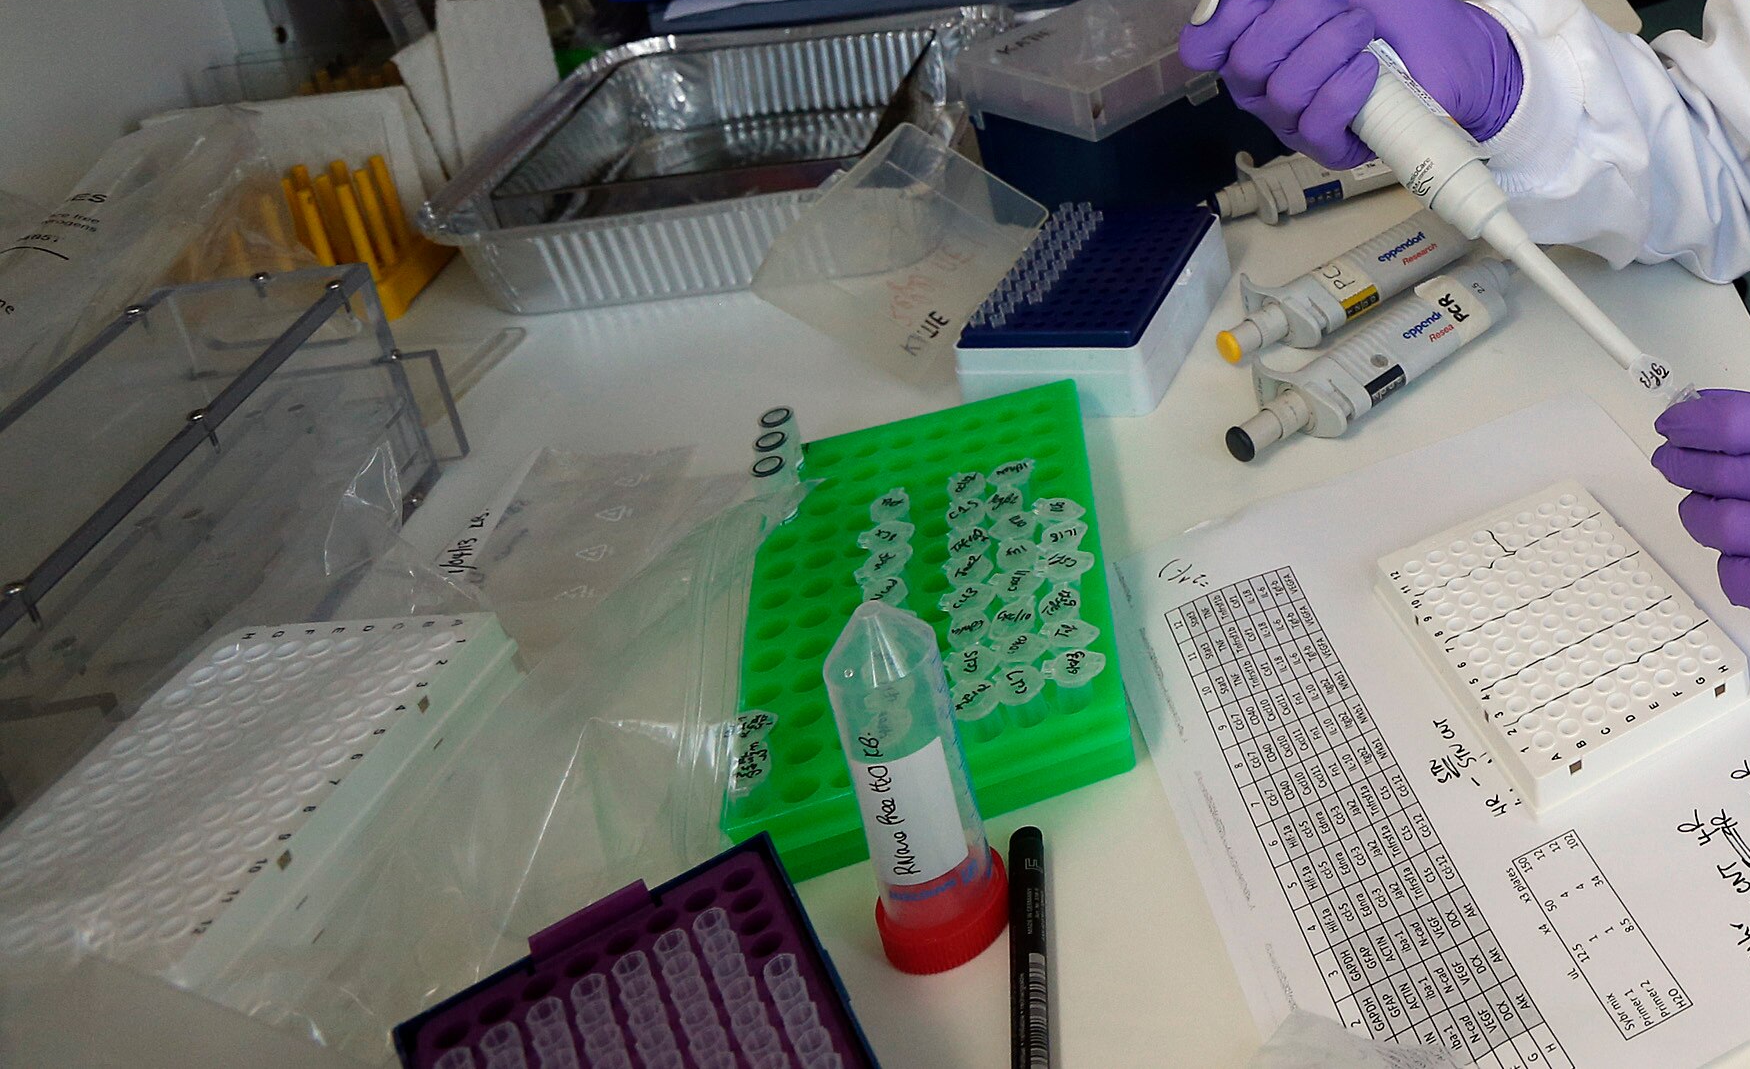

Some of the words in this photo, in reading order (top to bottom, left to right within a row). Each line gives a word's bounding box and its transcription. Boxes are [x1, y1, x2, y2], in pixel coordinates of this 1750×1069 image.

[1377, 230, 1427, 265] eppendorf
[1402, 242, 1438, 266] Research
[1438, 292, 1471, 323] PCR
[1402, 310, 1442, 341] eppend
[1428, 323, 1455, 344] Resea
[1389, 570, 1401, 580] 12
[1400, 585, 1411, 595] 11
[1411, 600, 1423, 609] 10
[1173, 619, 1184, 630] 12
[1435, 630, 1444, 638] 8
[1187, 651, 1198, 662] 11
[1457, 661, 1467, 669] 6
[1469, 677, 1480, 686] 5
[1201, 685, 1212, 696] 10
[1480, 694, 1491, 702] 4
[1494, 711, 1505, 720] 3
[1551, 751, 1563, 762] A
[1576, 740, 1587, 749] B
[1600, 726, 1611, 735] C
[1625, 714, 1636, 723] D
[1649, 701, 1660, 710] E
[1672, 690, 1683, 698] F
[1695, 677, 1706, 686] G
[1717, 664, 1729, 674] H
[1506, 728, 1517, 736] 2
[1520, 745, 1530, 754] 1
[1233, 761, 1244, 769] 8
[1267, 839, 1279, 847] 6
[1549, 841, 1562, 853] 12
[1563, 833, 1579, 850] 102
[1533, 848, 1546, 861] 12
[1518, 856, 1534, 874] 150
[1286, 881, 1298, 889] 5
[1505, 867, 1524, 894] plates
[1591, 875, 1604, 887] 34
[1519, 891, 1532, 904] x3
[1560, 891, 1569, 899] 4
[1544, 899, 1558, 912] 50
[1538, 922, 1552, 936] x4
[1604, 926, 1614, 934] 1
[1620, 917, 1635, 933] 8.5
[1588, 934, 1598, 942] 1
[1572, 942, 1591, 963] 12.5
[1327, 969, 1339, 978] 3
[1567, 966, 1580, 981] uL
[1640, 979, 1650, 988] 2
[1623, 988, 1633, 997] 1
[1668, 987, 1687, 1009] H2O
[1606, 992, 1625, 1011] mix
[1646, 987, 1671, 1018] Primer
[1629, 996, 1655, 1027] Primer
[1349, 1018, 1362, 1028] 2
[1618, 1010, 1635, 1031] Sybr
[1545, 1043, 1557, 1053] H
[1528, 1052, 1539, 1062] G
